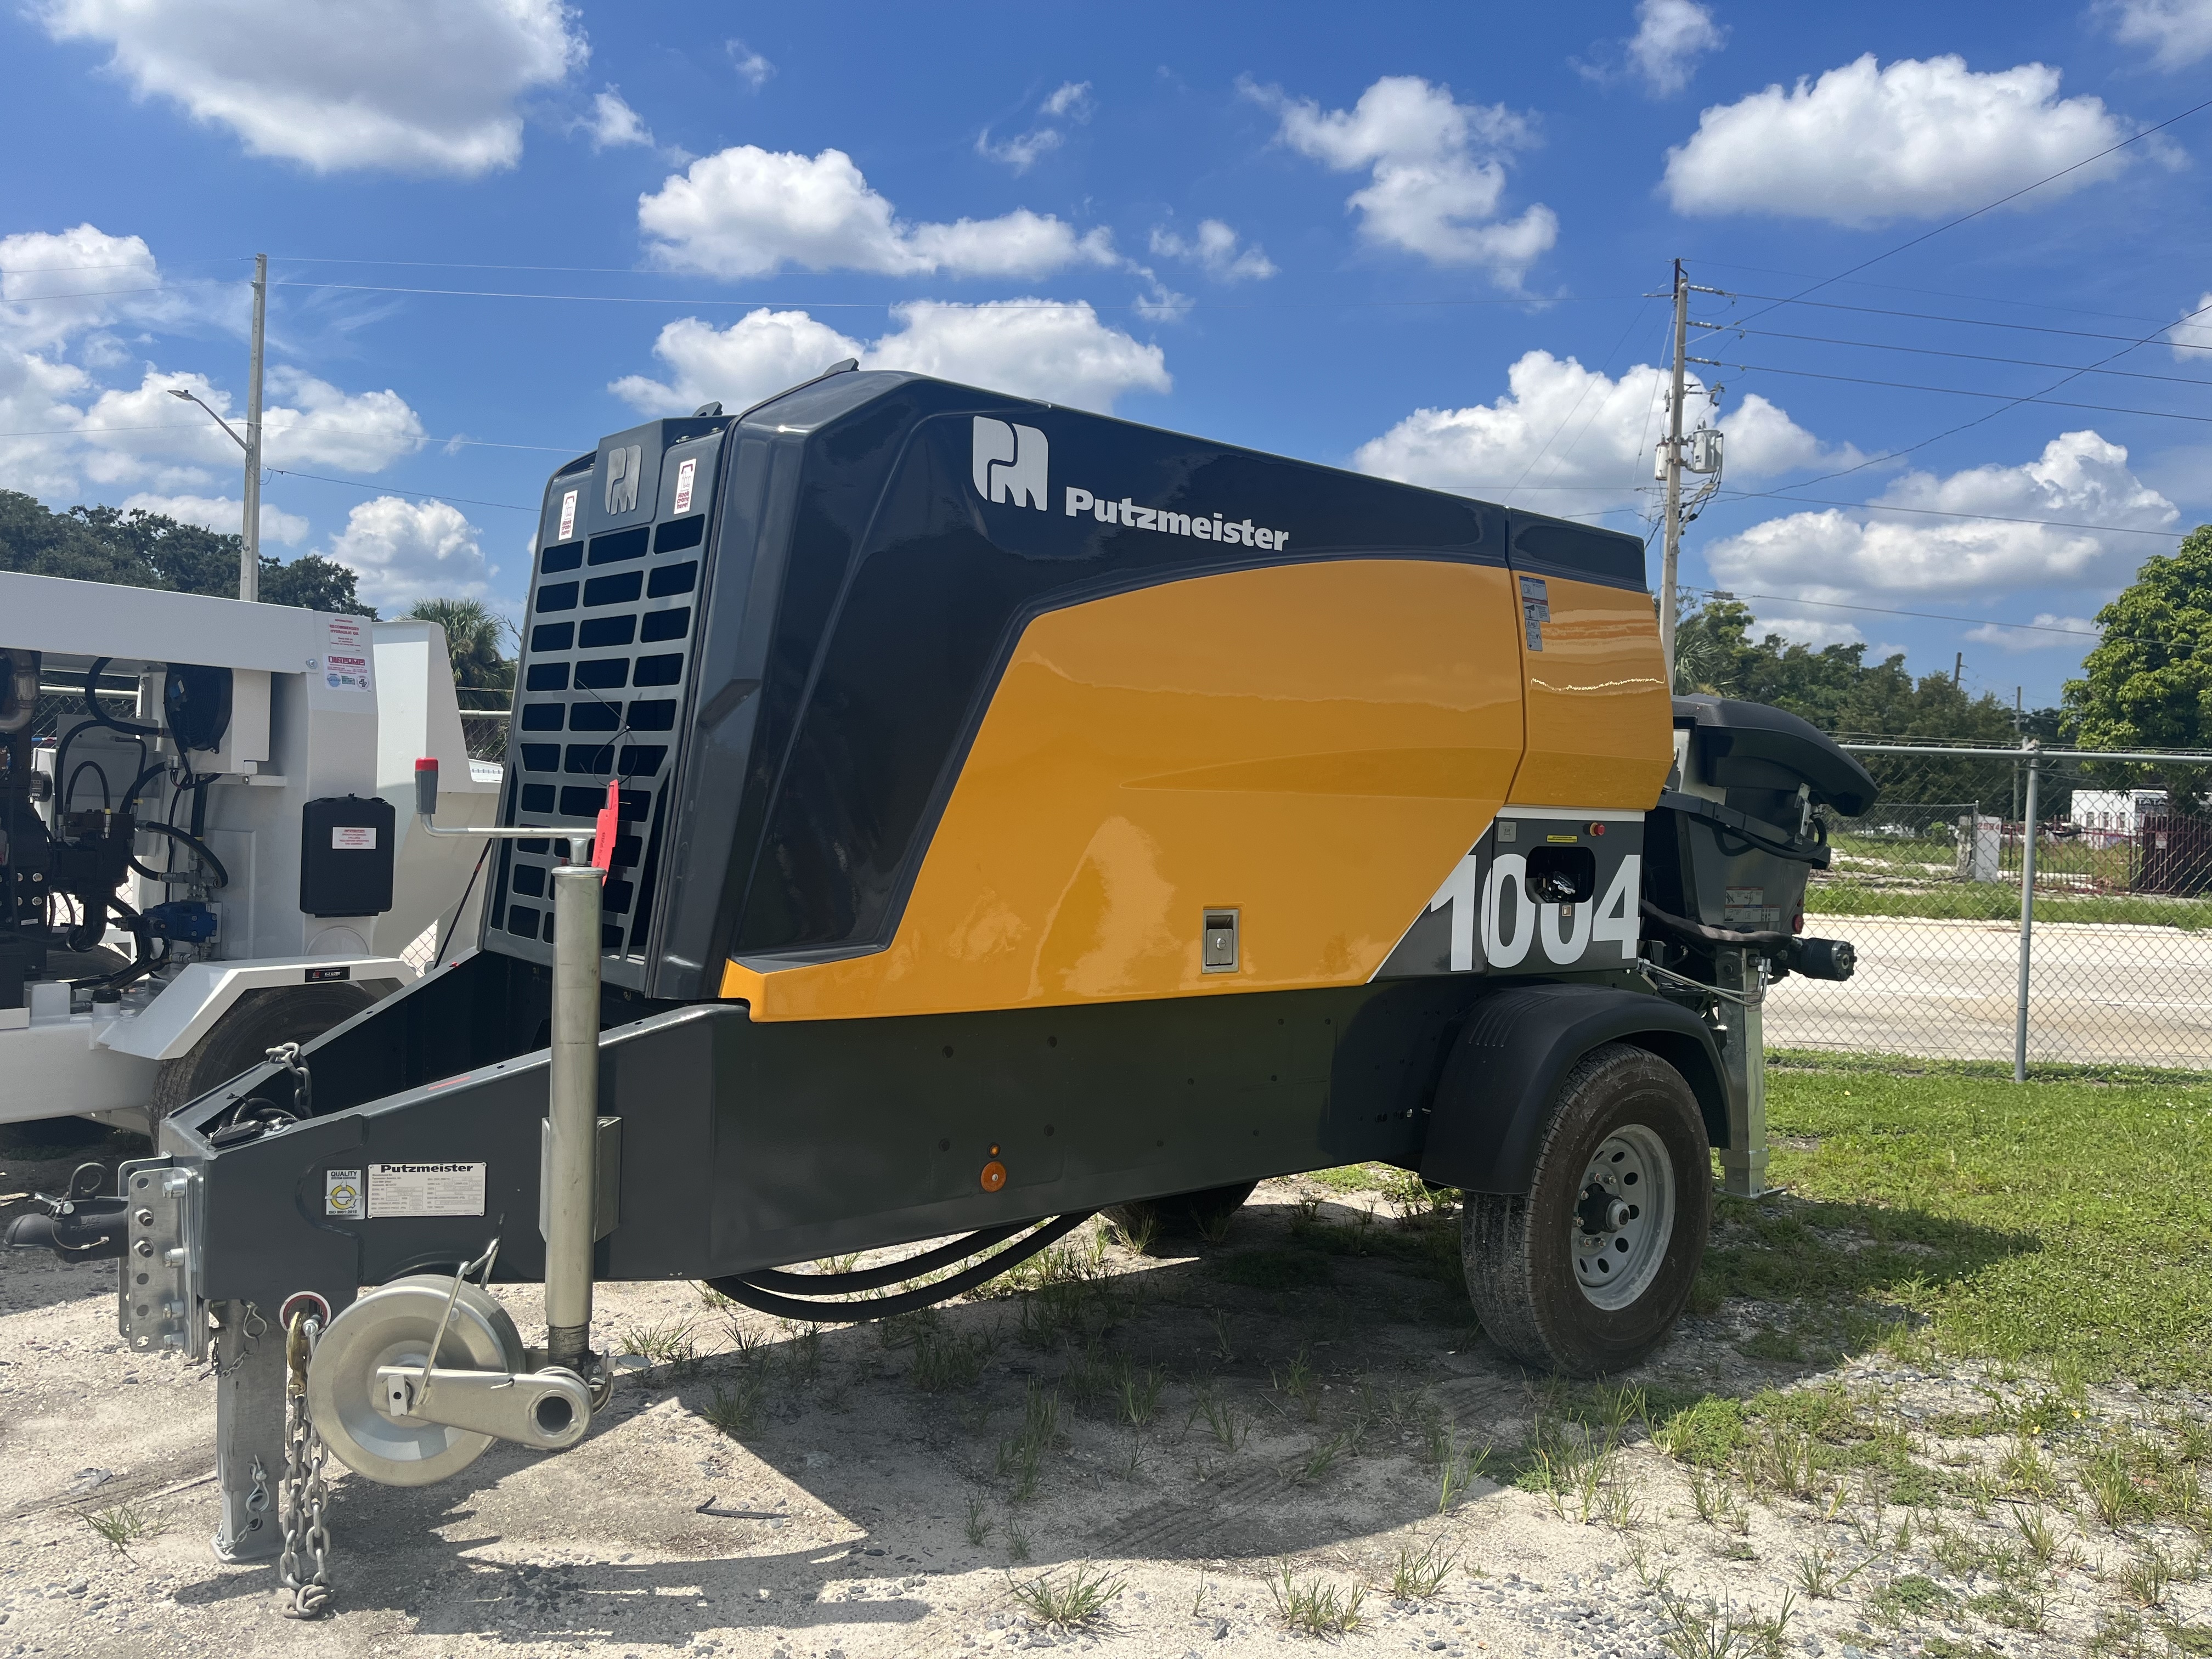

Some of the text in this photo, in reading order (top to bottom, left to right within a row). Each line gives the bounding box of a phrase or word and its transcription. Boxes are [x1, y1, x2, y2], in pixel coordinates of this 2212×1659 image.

[1065, 486, 1289, 551] Putzmeister
[1431, 854, 1640, 971] 1004
[381, 1164, 473, 1173] Putzmeister
